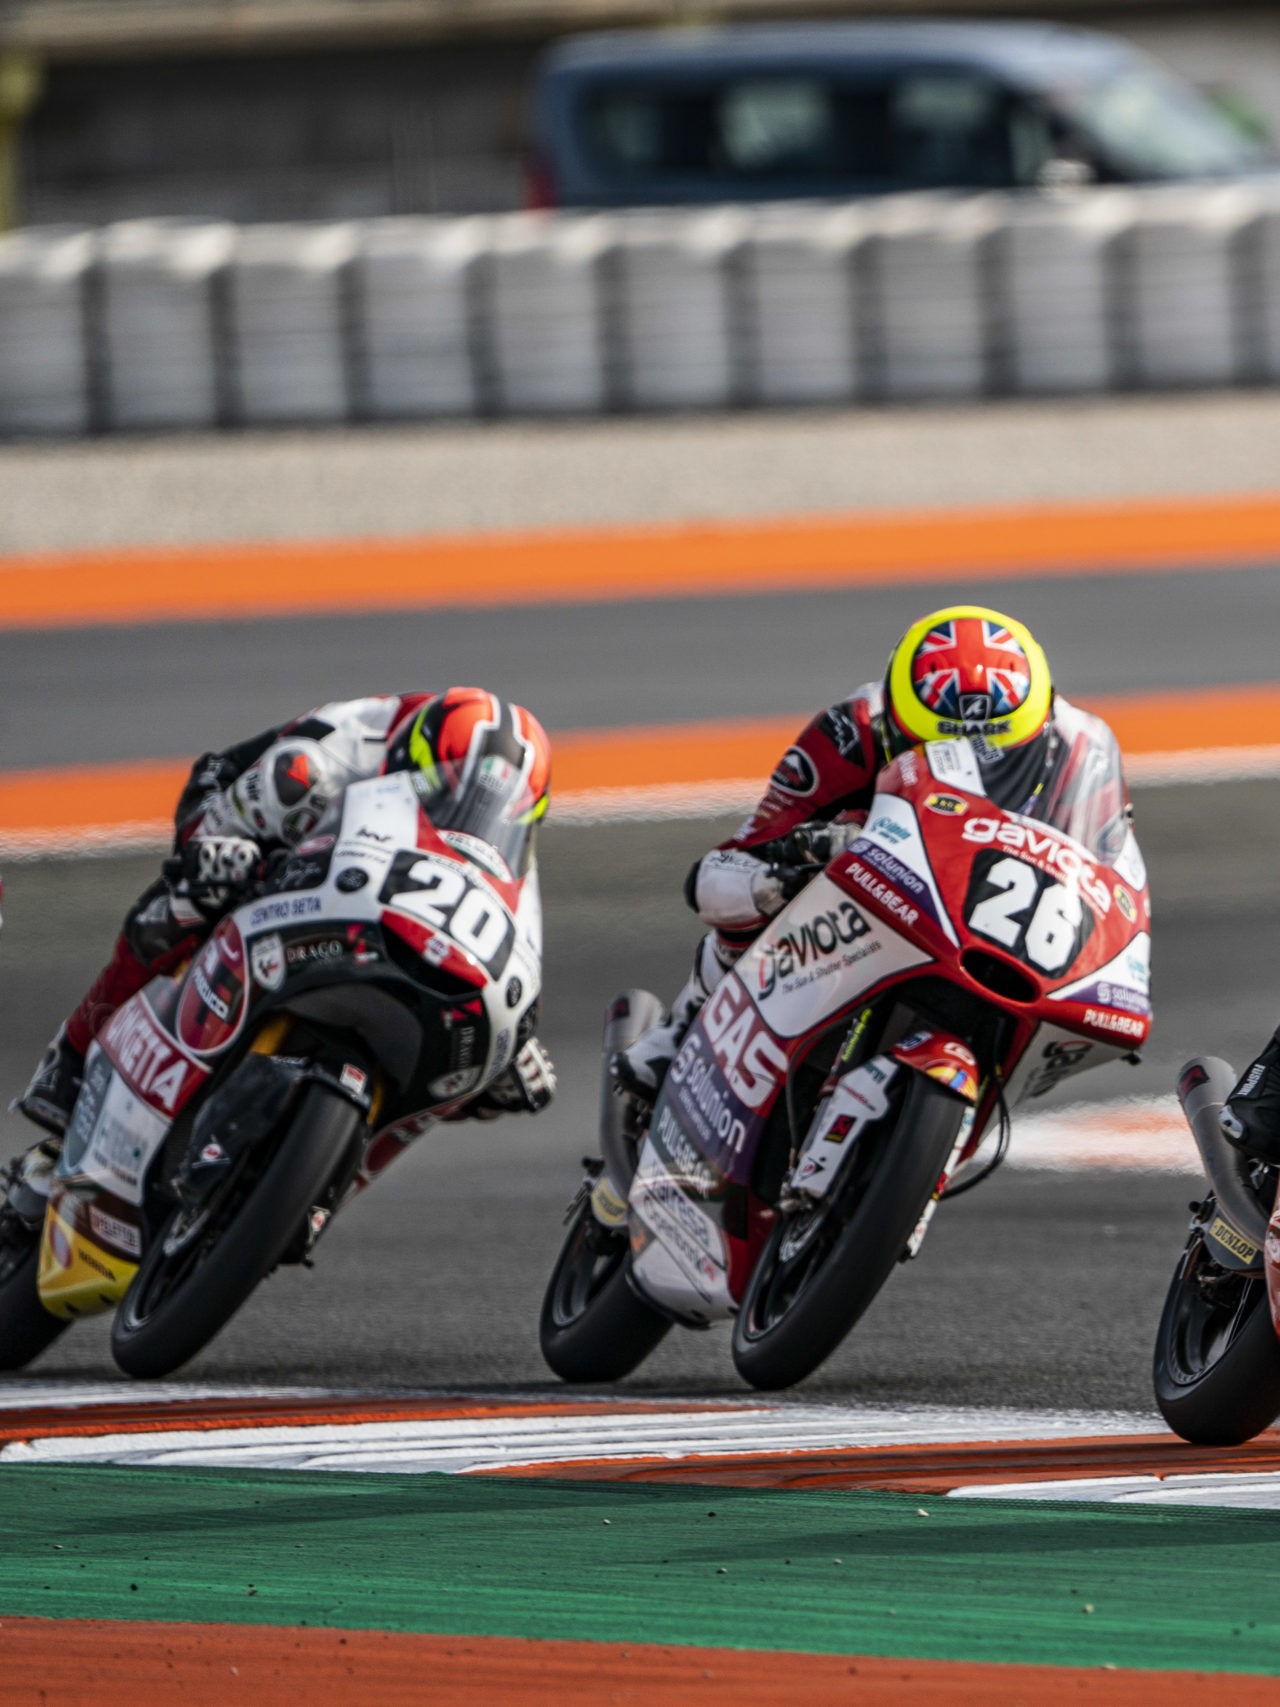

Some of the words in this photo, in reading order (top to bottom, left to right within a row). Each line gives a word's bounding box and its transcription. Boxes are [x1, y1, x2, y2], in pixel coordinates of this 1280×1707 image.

[937, 720, 1011, 736] SHARK
[845, 861, 919, 927] PULL&BEAR
[867, 847, 926, 895] solunion
[389, 859, 509, 964] 20
[968, 857, 1083, 971] 26
[703, 971, 789, 1109] GAS
[1083, 1008, 1145, 1039] PULL&BEAR
[1214, 1223, 1256, 1262] DUNLOP
